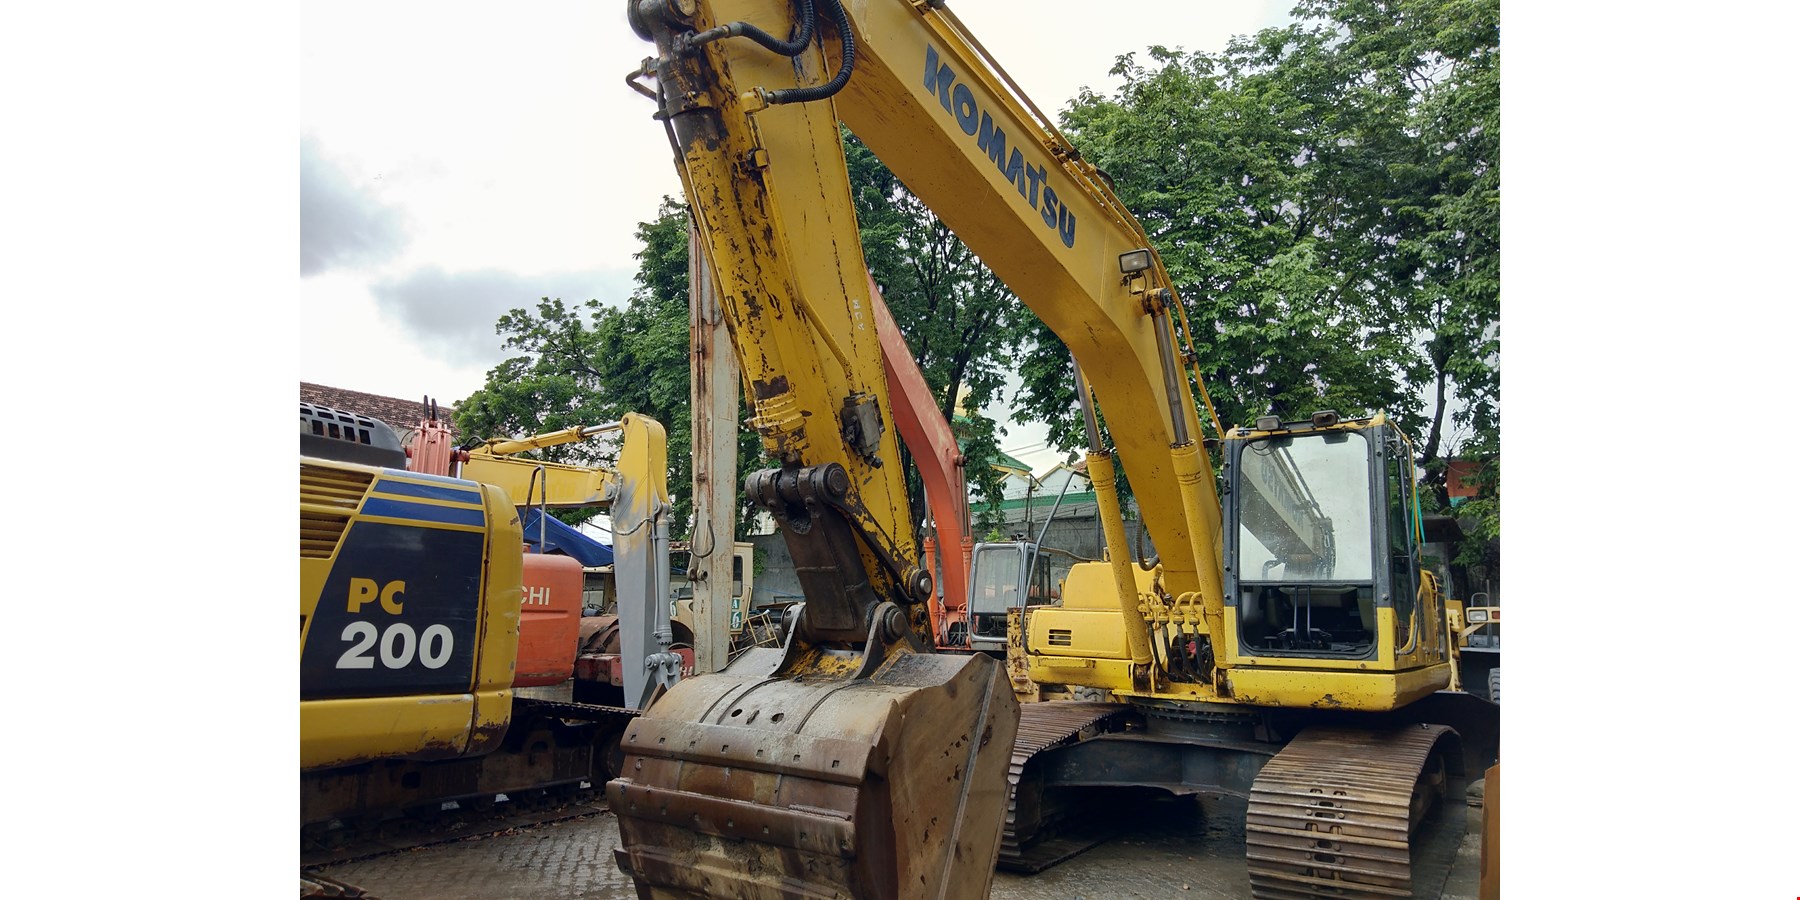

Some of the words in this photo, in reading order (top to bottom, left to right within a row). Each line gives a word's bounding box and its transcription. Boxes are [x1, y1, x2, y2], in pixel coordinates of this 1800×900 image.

[923, 42, 1076, 249] KOMATSU
[347, 577, 406, 615] PC
[521, 585, 551, 606] CHI
[335, 620, 455, 670] 200
